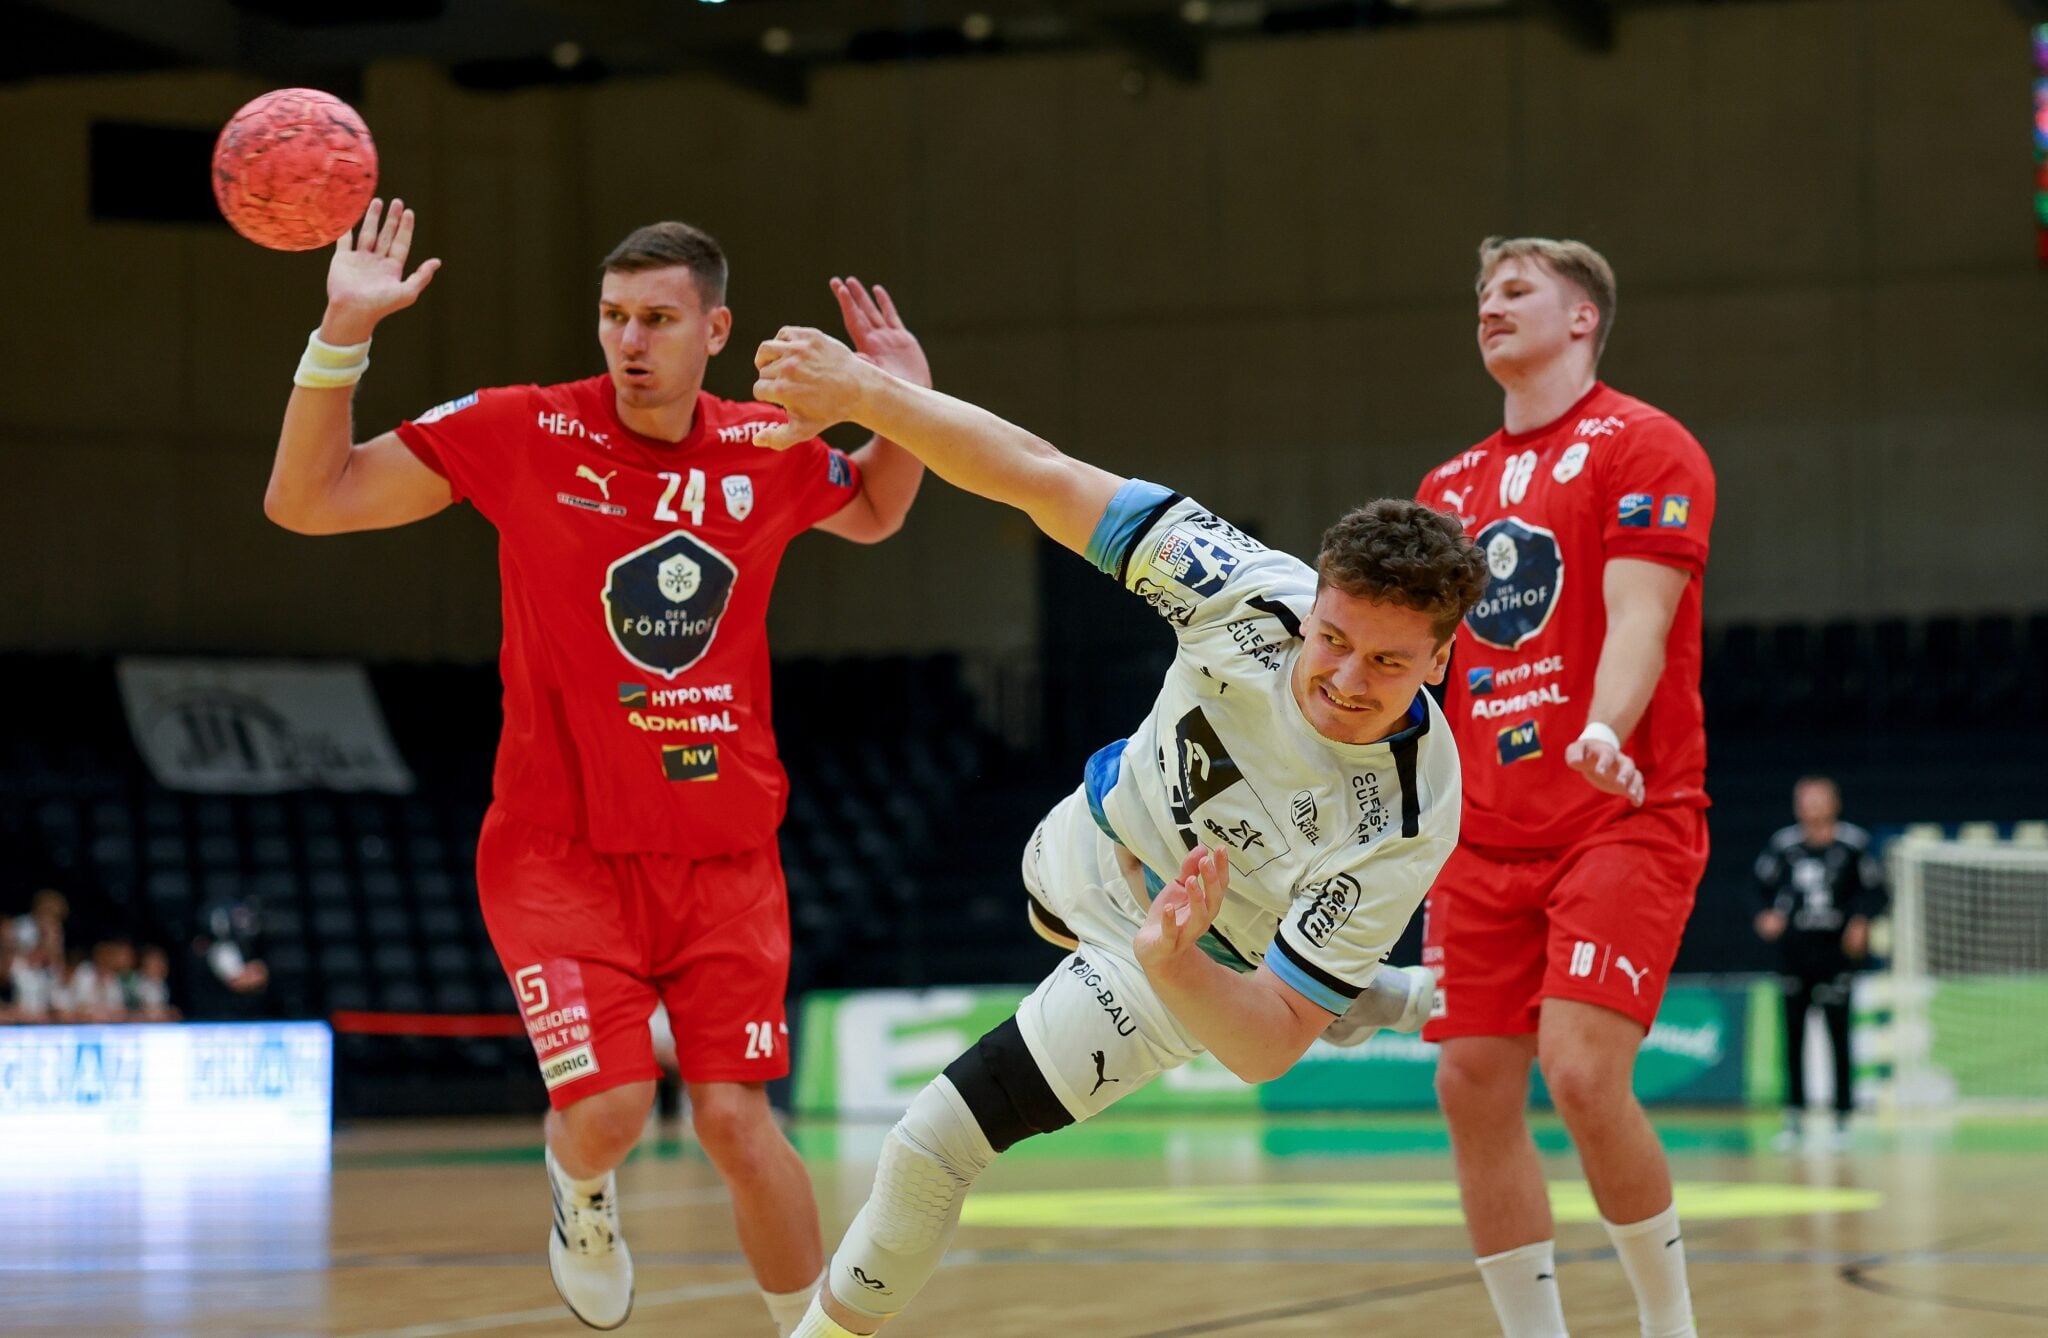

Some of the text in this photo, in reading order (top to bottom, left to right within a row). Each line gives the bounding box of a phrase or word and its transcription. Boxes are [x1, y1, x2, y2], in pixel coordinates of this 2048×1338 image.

[1499, 449, 1538, 509] 18
[653, 467, 706, 527] 24
[1159, 534, 1180, 560] MOLY
[1167, 539, 1189, 566] LIQUI
[1172, 554, 1194, 580] HBL
[665, 609, 688, 621] DER
[651, 687, 702, 708] HYPO
[1471, 683, 1569, 720] ADMIRAL
[628, 710, 739, 734] ADMIRAL
[1511, 727, 1533, 746] NV
[682, 749, 712, 766] NV
[1203, 818, 1239, 848] star
[1297, 822, 1320, 846] KIEL
[1304, 817, 1320, 832] THW
[1569, 940, 1597, 978] 18
[1074, 963, 1137, 1037] BIG-BAU
[744, 1021, 773, 1060] 24
